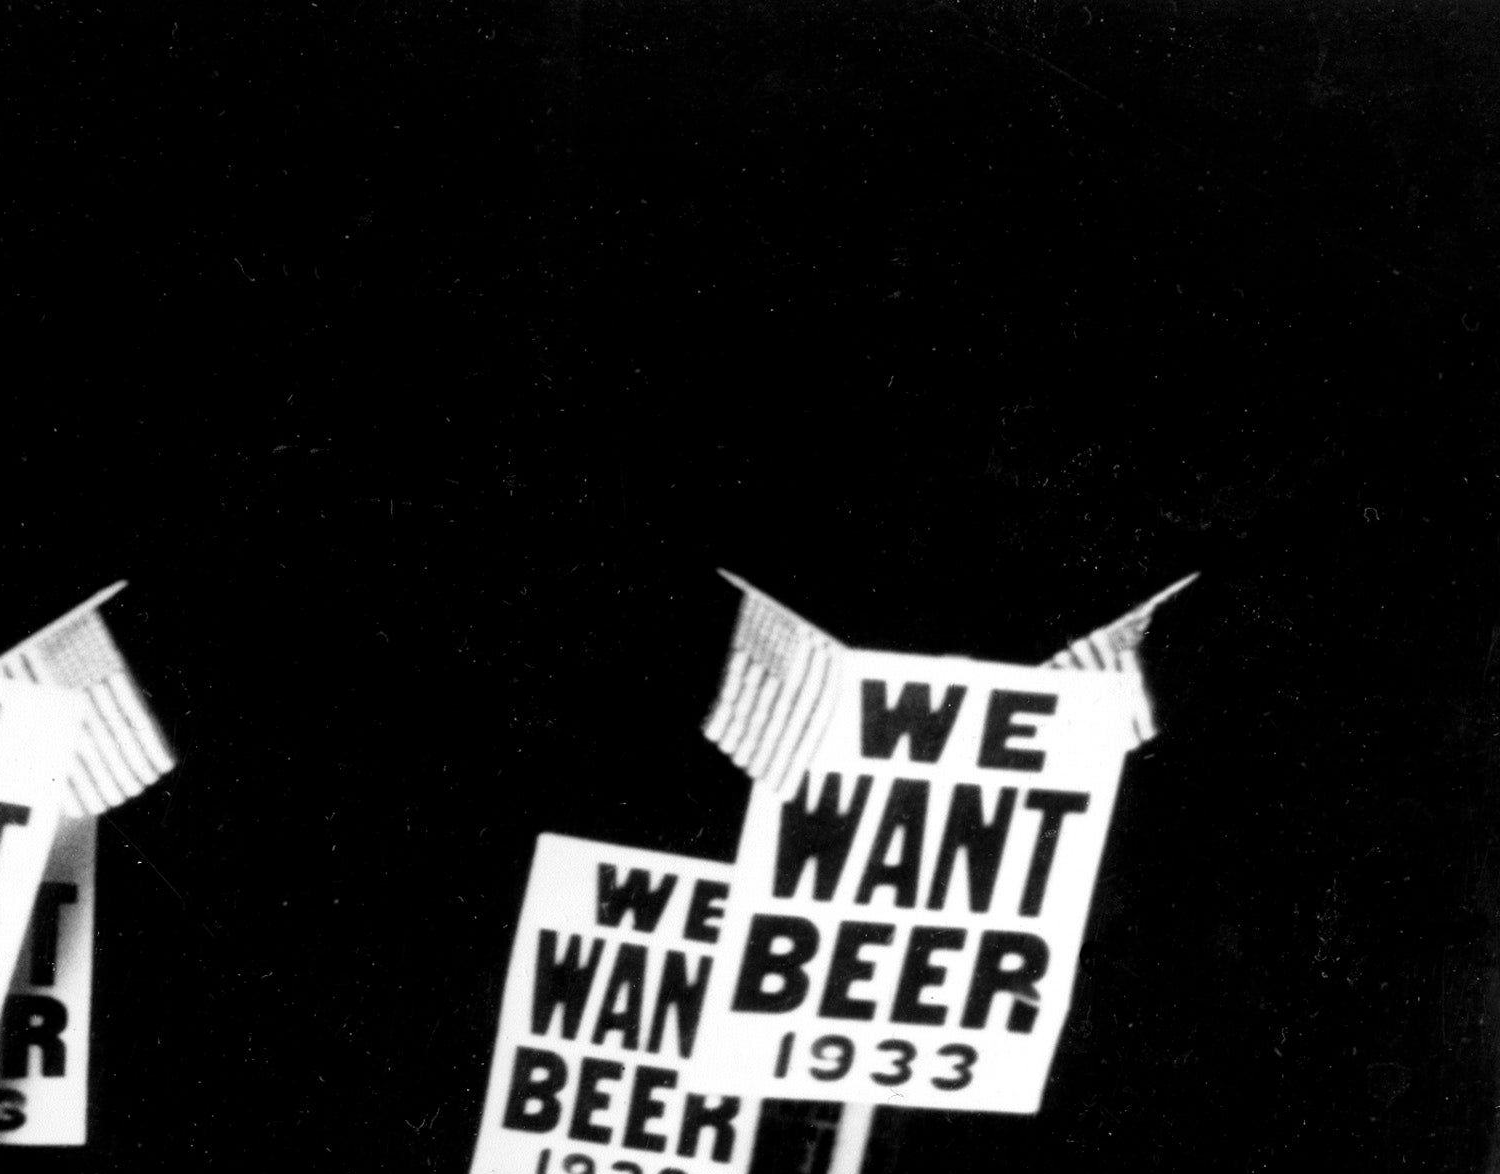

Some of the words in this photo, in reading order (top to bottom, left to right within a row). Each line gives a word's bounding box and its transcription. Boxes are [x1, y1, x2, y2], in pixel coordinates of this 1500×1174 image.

[860, 679, 1058, 772] WE
[596, 862, 730, 945] WE
[772, 770, 1091, 918] WANT
[530, 929, 713, 1059] WAN
[730, 913, 1050, 1034] BEER
[502, 1045, 742, 1164] BEER
[775, 1031, 979, 1091] 1933
